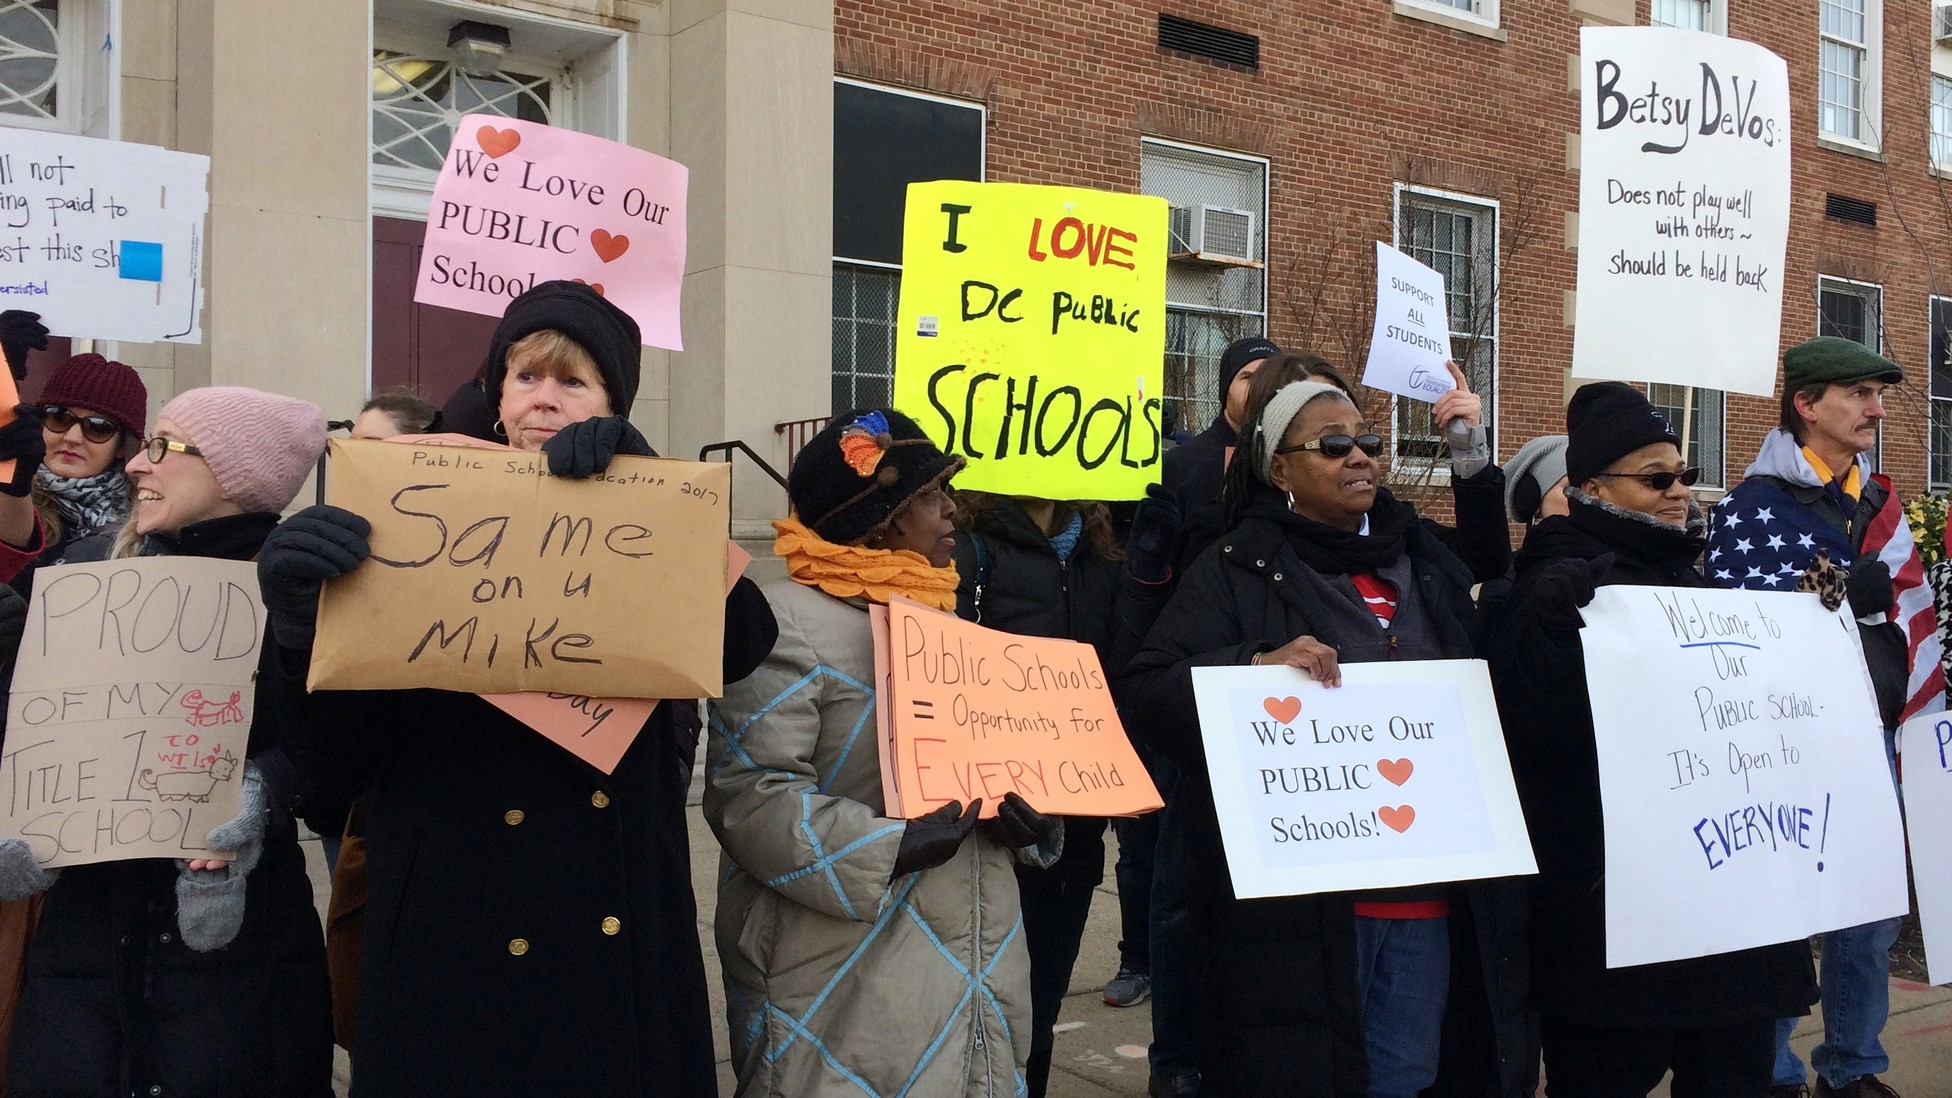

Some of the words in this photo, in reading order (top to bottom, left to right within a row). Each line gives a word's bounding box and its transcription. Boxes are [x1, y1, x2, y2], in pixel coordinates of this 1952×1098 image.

[1595, 59, 1691, 154] Betsy
[1698, 62, 1782, 147] DeVos:
[30, 155, 75, 186] not
[455, 148, 499, 183] We
[519, 160, 605, 205] Love
[623, 187, 670, 225] Our
[46, 188, 94, 227] paid
[103, 196, 128, 220] to
[1607, 178, 1651, 205] Does
[1656, 180, 1686, 208] not
[1692, 183, 1722, 228] play
[1726, 188, 1753, 219] well
[40, 233, 83, 262] this
[437, 200, 580, 254] PUBLIC
[940, 203, 972, 253] I
[1028, 217, 1138, 271] LOVE
[1655, 215, 1689, 239] with
[1694, 214, 1734, 241] others
[1675, 249, 1694, 279] be
[1700, 249, 1728, 283] held
[961, 280, 1024, 323] DC
[1391, 277, 1435, 307] SUPPORT
[1407, 308, 1425, 326] ALL
[1386, 325, 1443, 356] STUDENTS
[927, 363, 1161, 471] SCHOOLS
[412, 450, 484, 470] Public
[504, 460, 562, 479] Schoo
[680, 482, 719, 506] 2017
[472, 575, 523, 603] on
[564, 570, 592, 600] u
[41, 568, 257, 661] PROUD
[1654, 590, 1757, 643] Welcome
[1755, 601, 1781, 639] to
[903, 615, 991, 686] Public
[1002, 643, 1103, 692] Schools
[1711, 643, 1749, 681] Our
[22, 691, 88, 725] OF
[107, 682, 183, 719] MY
[547, 692, 614, 737] ay
[952, 693, 1061, 741] Opportunity
[1250, 720, 1296, 747] We
[1310, 718, 1375, 744] Love
[1388, 715, 1435, 741] Our
[3, 739, 99, 817] TITLE
[913, 737, 1050, 802] EVERY
[1058, 760, 1125, 794] Child
[1260, 763, 1372, 795] PUBLIC
[1667, 749, 1710, 790] It's
[1728, 741, 1773, 795] Open
[1780, 734, 1801, 766] to
[20, 807, 207, 864] SCHOOL
[1270, 811, 1381, 844] Schools!
